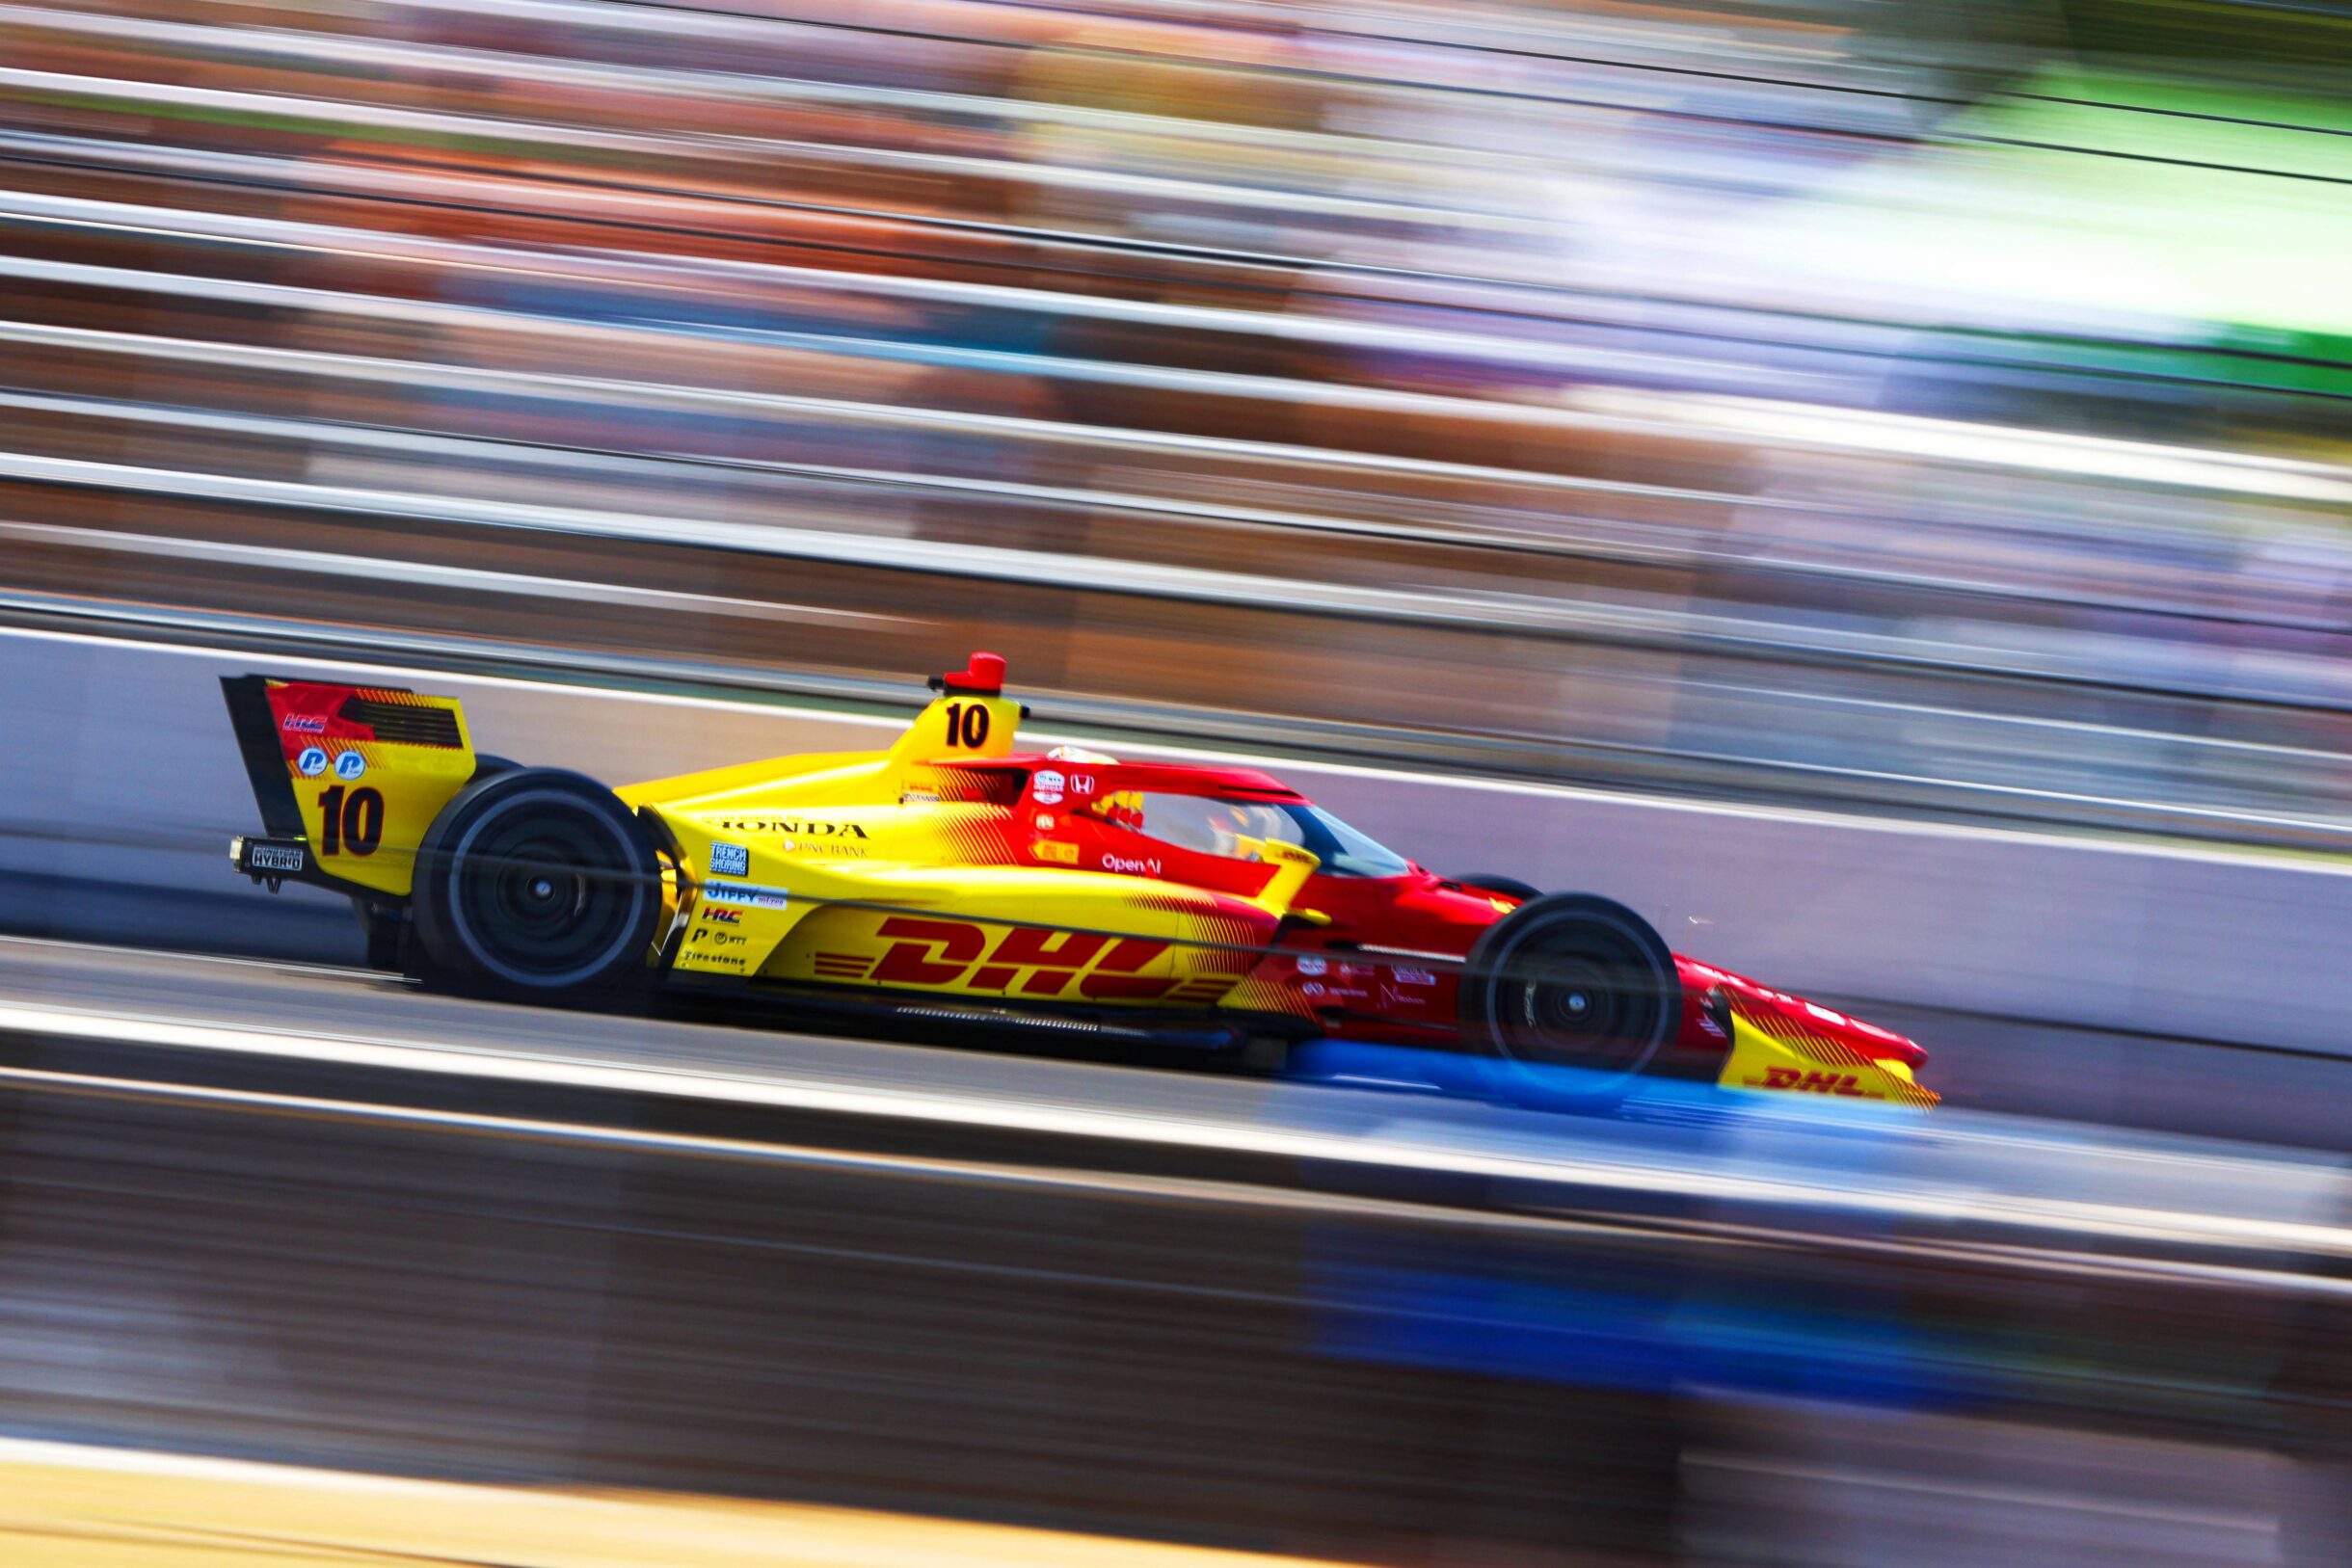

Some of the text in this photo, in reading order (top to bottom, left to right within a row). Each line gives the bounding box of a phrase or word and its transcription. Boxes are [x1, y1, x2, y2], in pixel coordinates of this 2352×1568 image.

[946, 703, 990, 749] 10
[317, 784, 385, 857] 10
[254, 853, 301, 870] HYBRID
[711, 842, 747, 862] TRENCH
[684, 949, 745, 965] Firestone
[869, 917, 1183, 999] DHL
[1760, 1065, 1863, 1097] DHL
